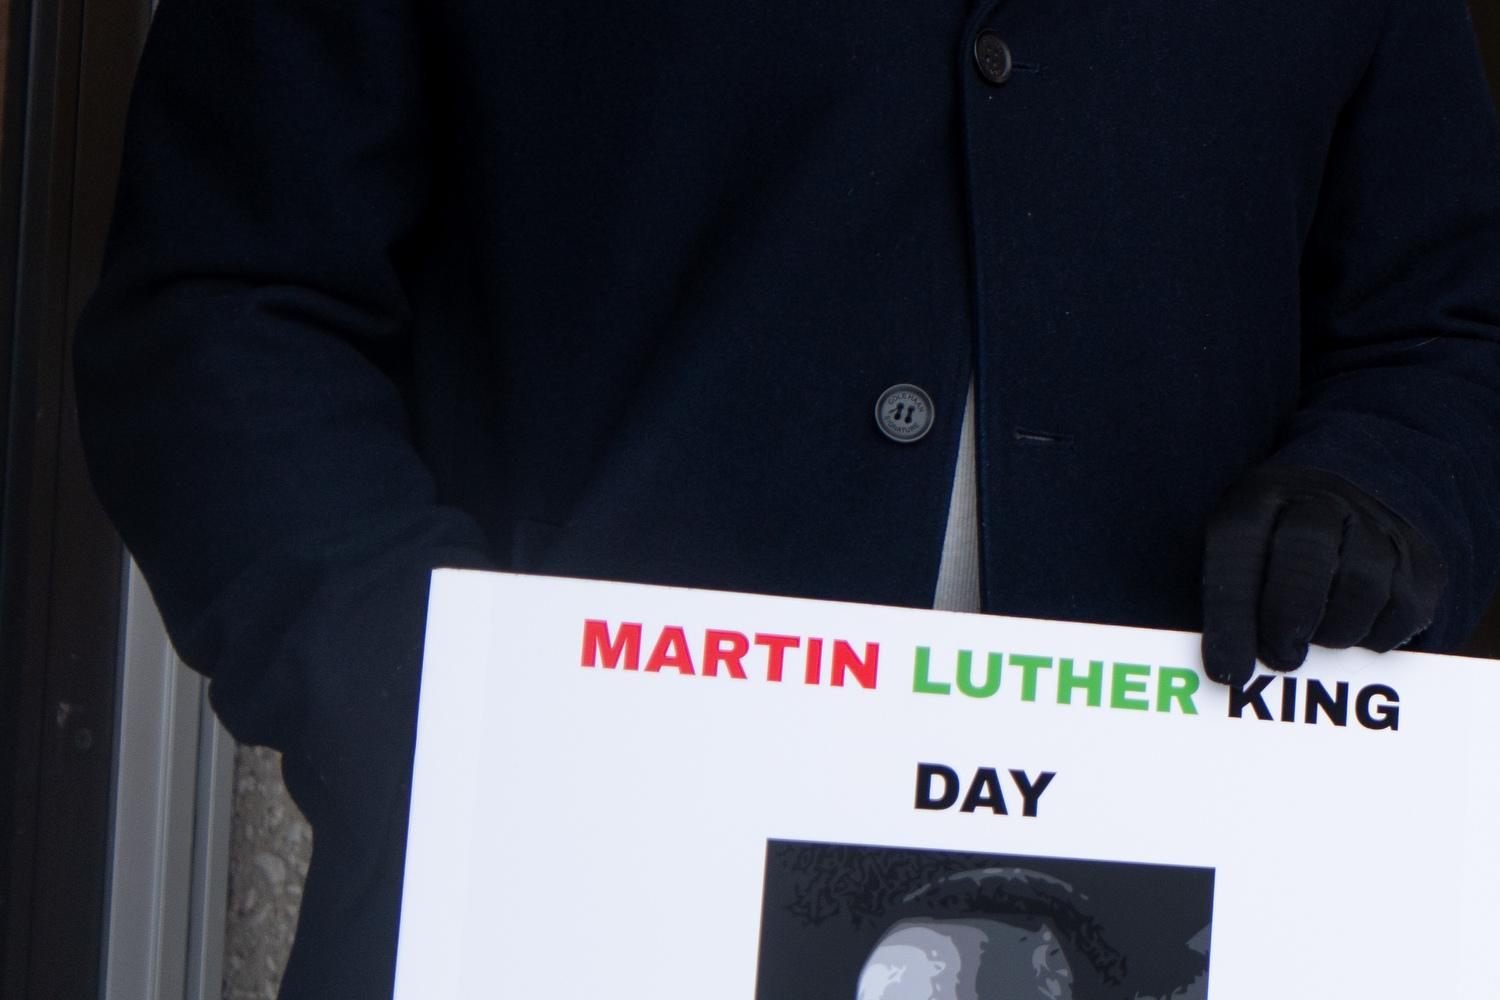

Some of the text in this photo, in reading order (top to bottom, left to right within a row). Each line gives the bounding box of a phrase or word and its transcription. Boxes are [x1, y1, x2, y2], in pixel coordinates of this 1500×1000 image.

[887, 392, 925, 413] COLE HAAN
[883, 415, 920, 433] SIGNATURE
[581, 619, 1401, 732] MARTIN LUTHER KING
[915, 763, 1056, 818] DAY
